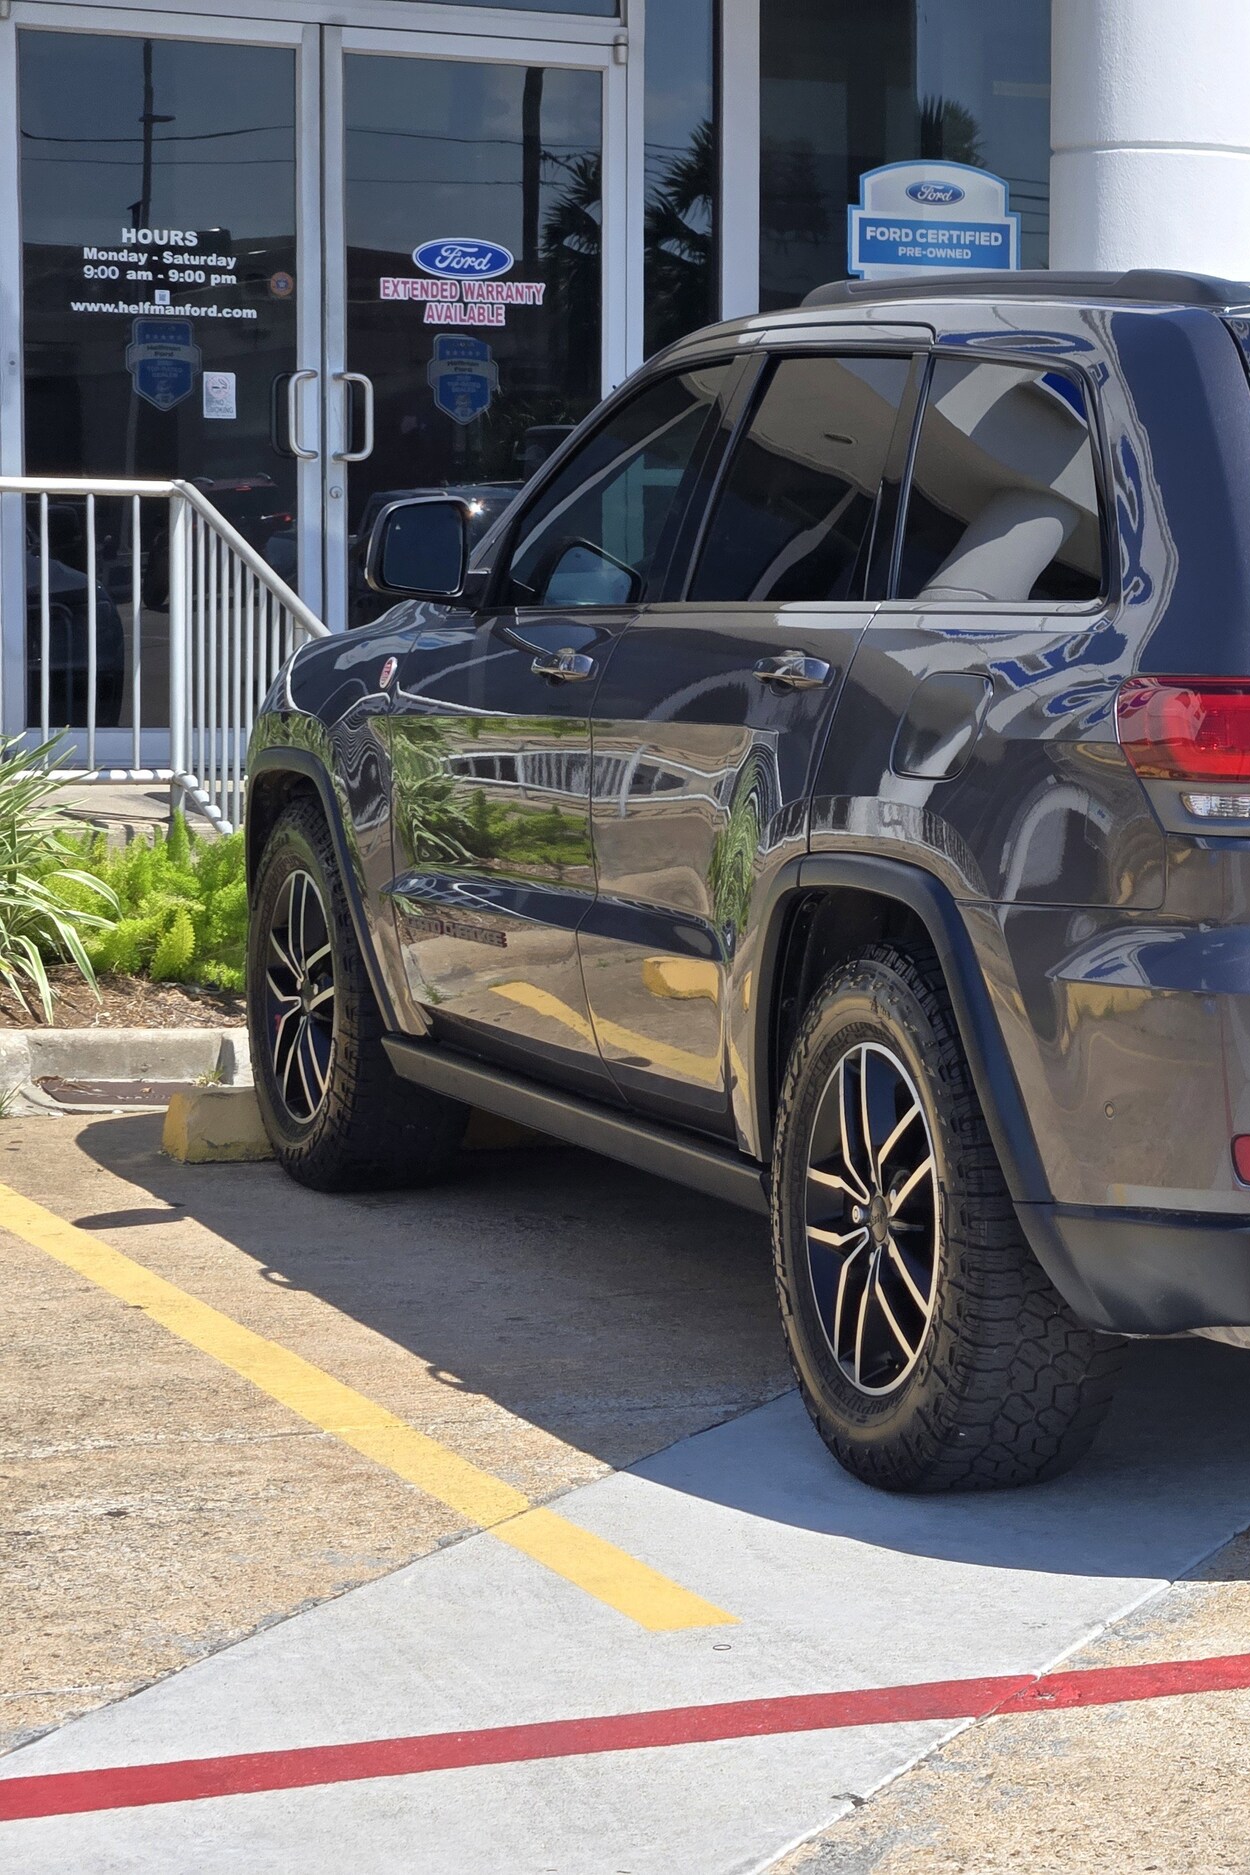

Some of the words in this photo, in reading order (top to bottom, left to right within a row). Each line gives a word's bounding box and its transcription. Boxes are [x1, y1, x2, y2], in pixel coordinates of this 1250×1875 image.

[917, 184, 953, 202] Ford
[121, 227, 198, 246] HOURS
[866, 226, 913, 242] FORD
[915, 229, 1003, 246] CERTIFIED
[83, 247, 148, 265] Monday
[162, 250, 237, 270] Saturday
[435, 245, 493, 271] Ford
[898, 246, 972, 260] PRE-OWNED
[83, 264, 120, 279] 9:00
[126, 269, 153, 281] am
[168, 269, 206, 283] 9:00
[210, 273, 237, 287] pm
[381, 278, 459, 301] EXTENDED
[463, 281, 545, 305] WARRANTY
[70, 300, 258, 319] www.helfmanford.com
[424, 303, 505, 324] AVAILABLE
